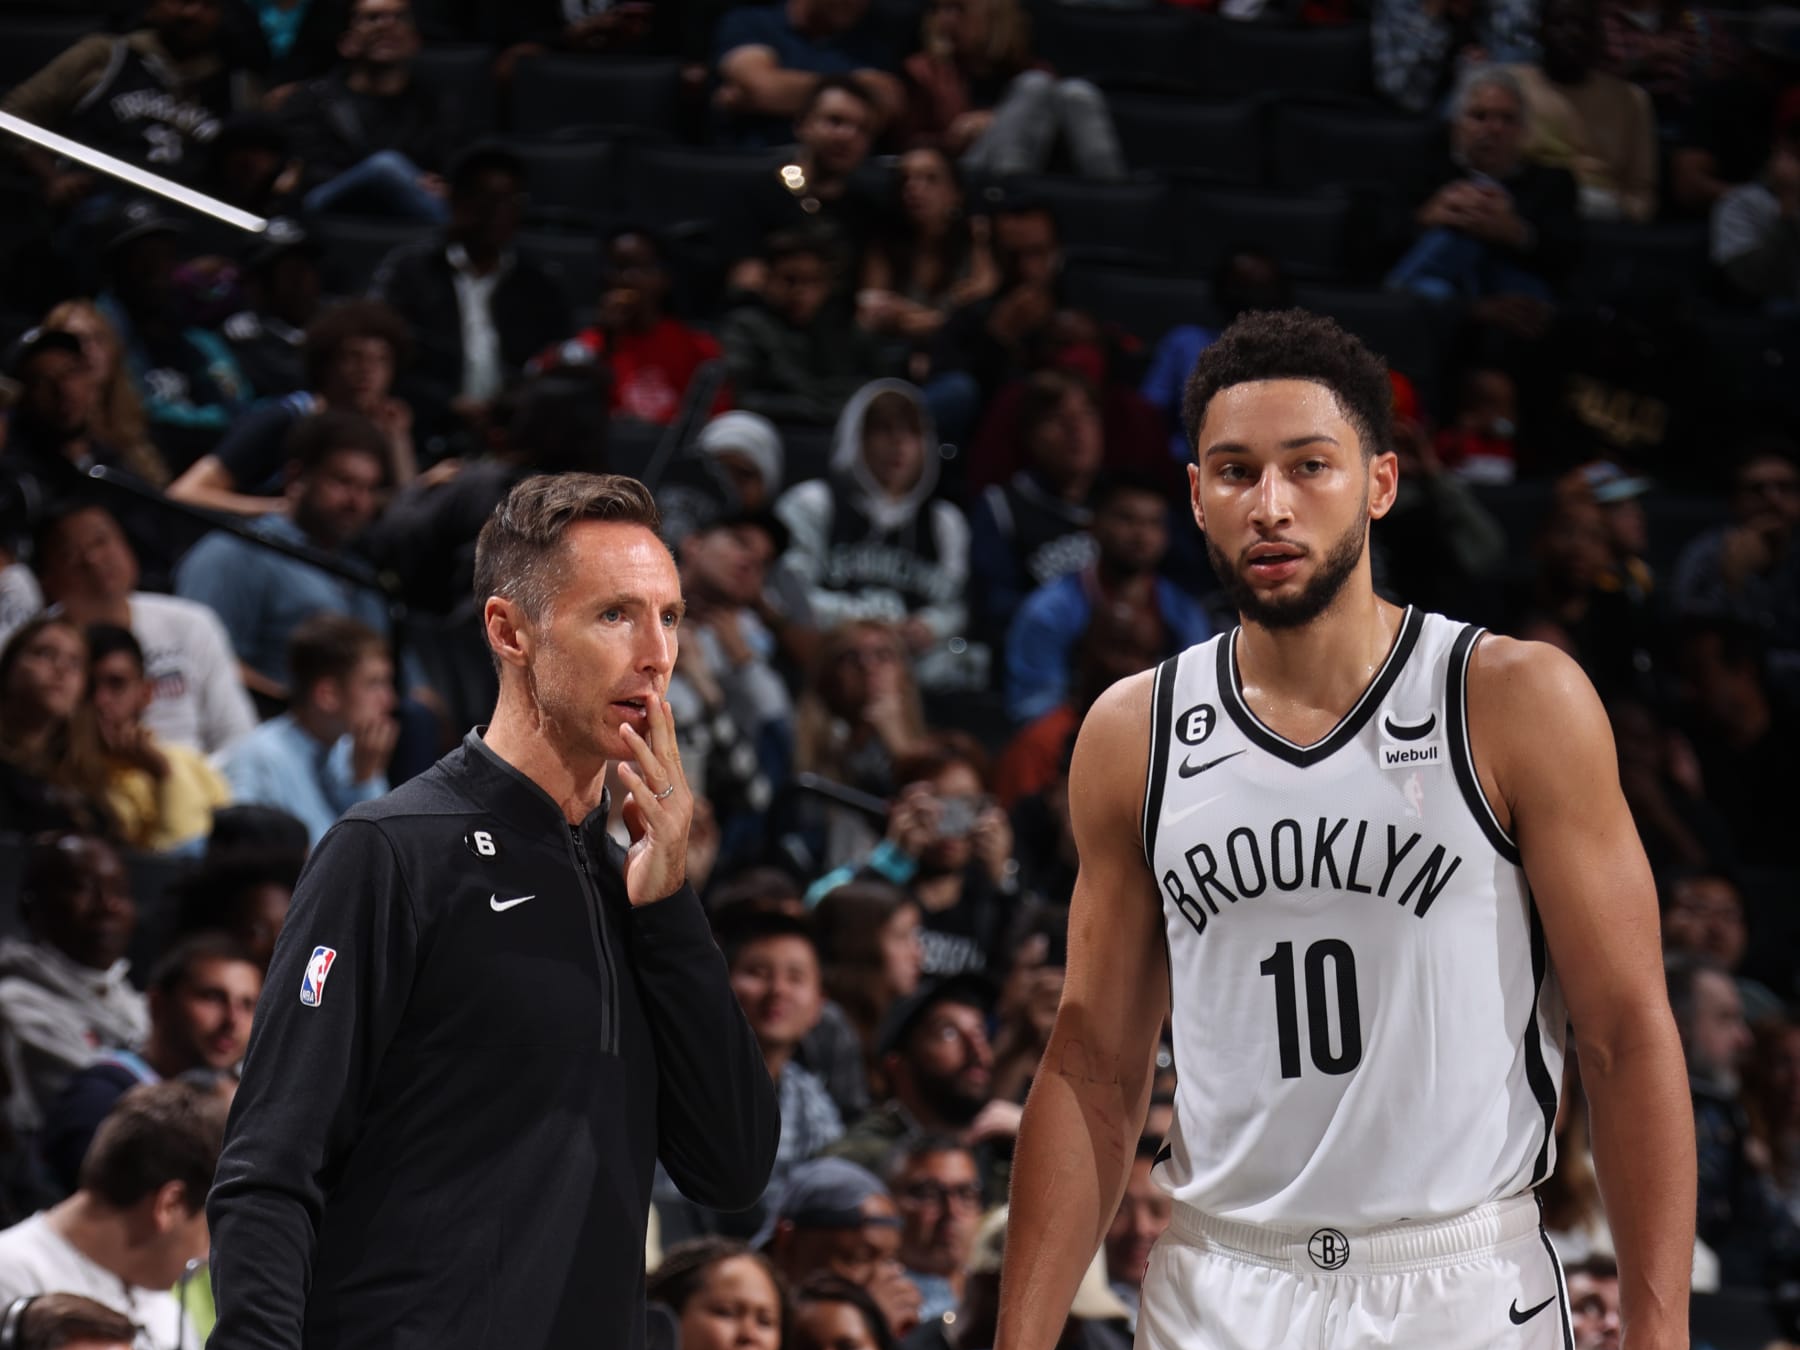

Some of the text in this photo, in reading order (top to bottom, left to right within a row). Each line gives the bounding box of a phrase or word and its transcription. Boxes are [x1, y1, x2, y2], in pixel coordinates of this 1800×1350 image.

[1186, 709, 1208, 741] 6
[1386, 746, 1438, 764] Webull
[474, 831, 496, 856] 6
[1163, 817, 1462, 936] BROOKLYN
[1259, 938, 1362, 1079] 10
